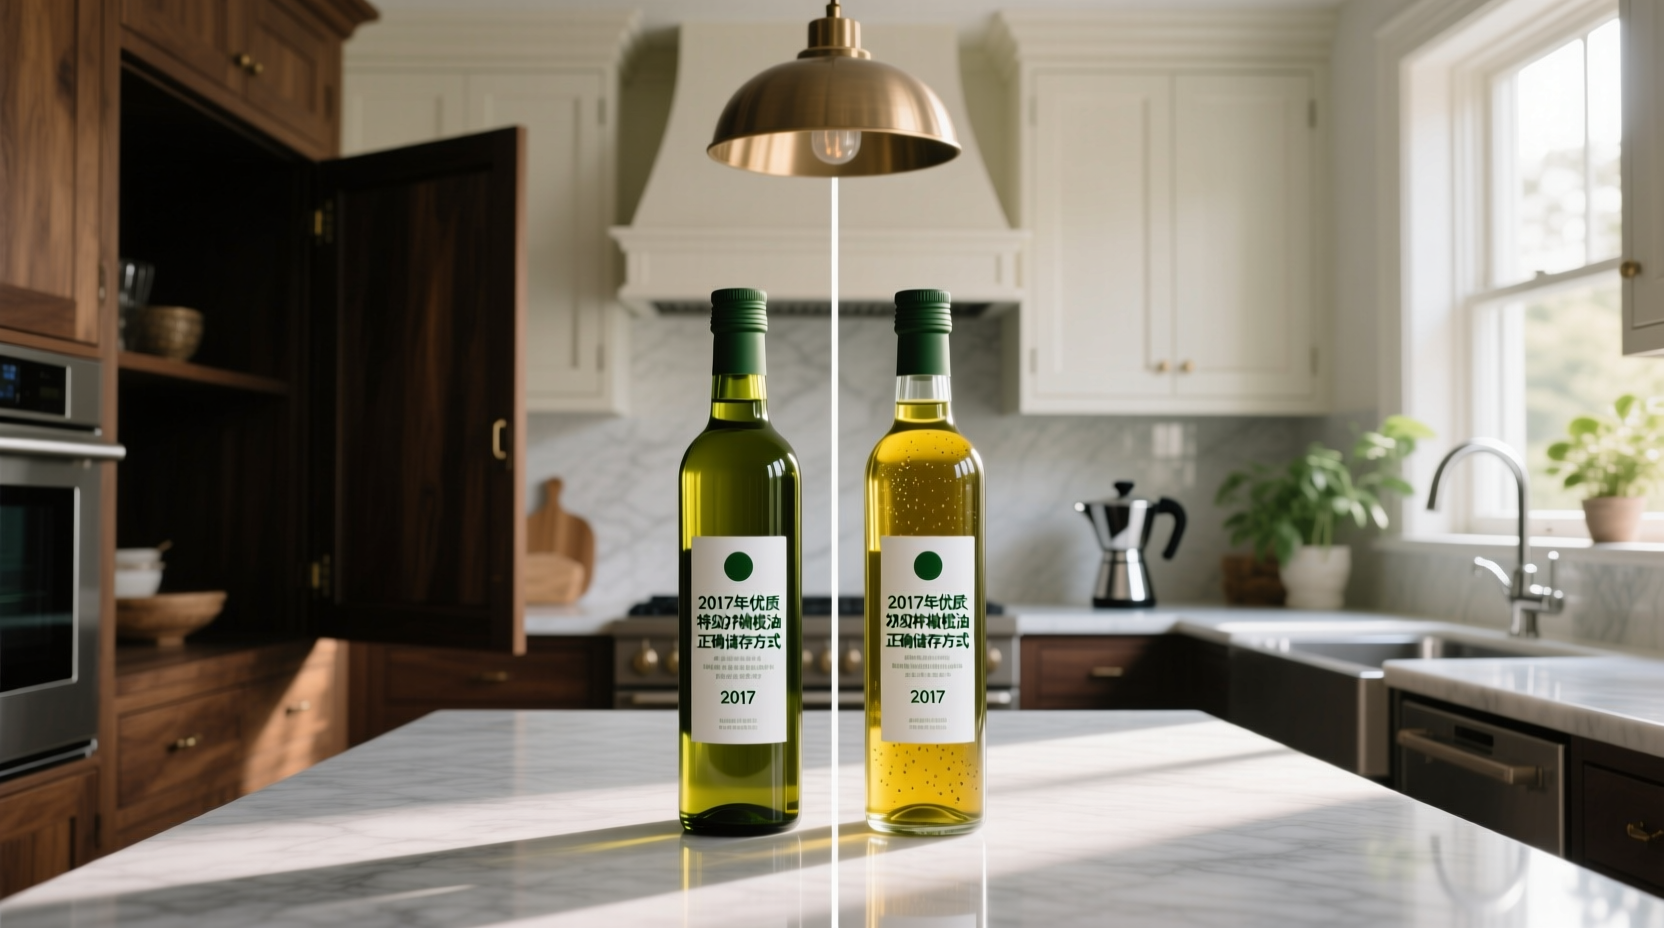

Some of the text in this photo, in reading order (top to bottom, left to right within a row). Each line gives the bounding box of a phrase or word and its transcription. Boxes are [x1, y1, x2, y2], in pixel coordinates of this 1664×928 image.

[698, 594, 780, 611] 2017年优质
[720, 690, 756, 705] 2017
[910, 689, 946, 704] 2017
